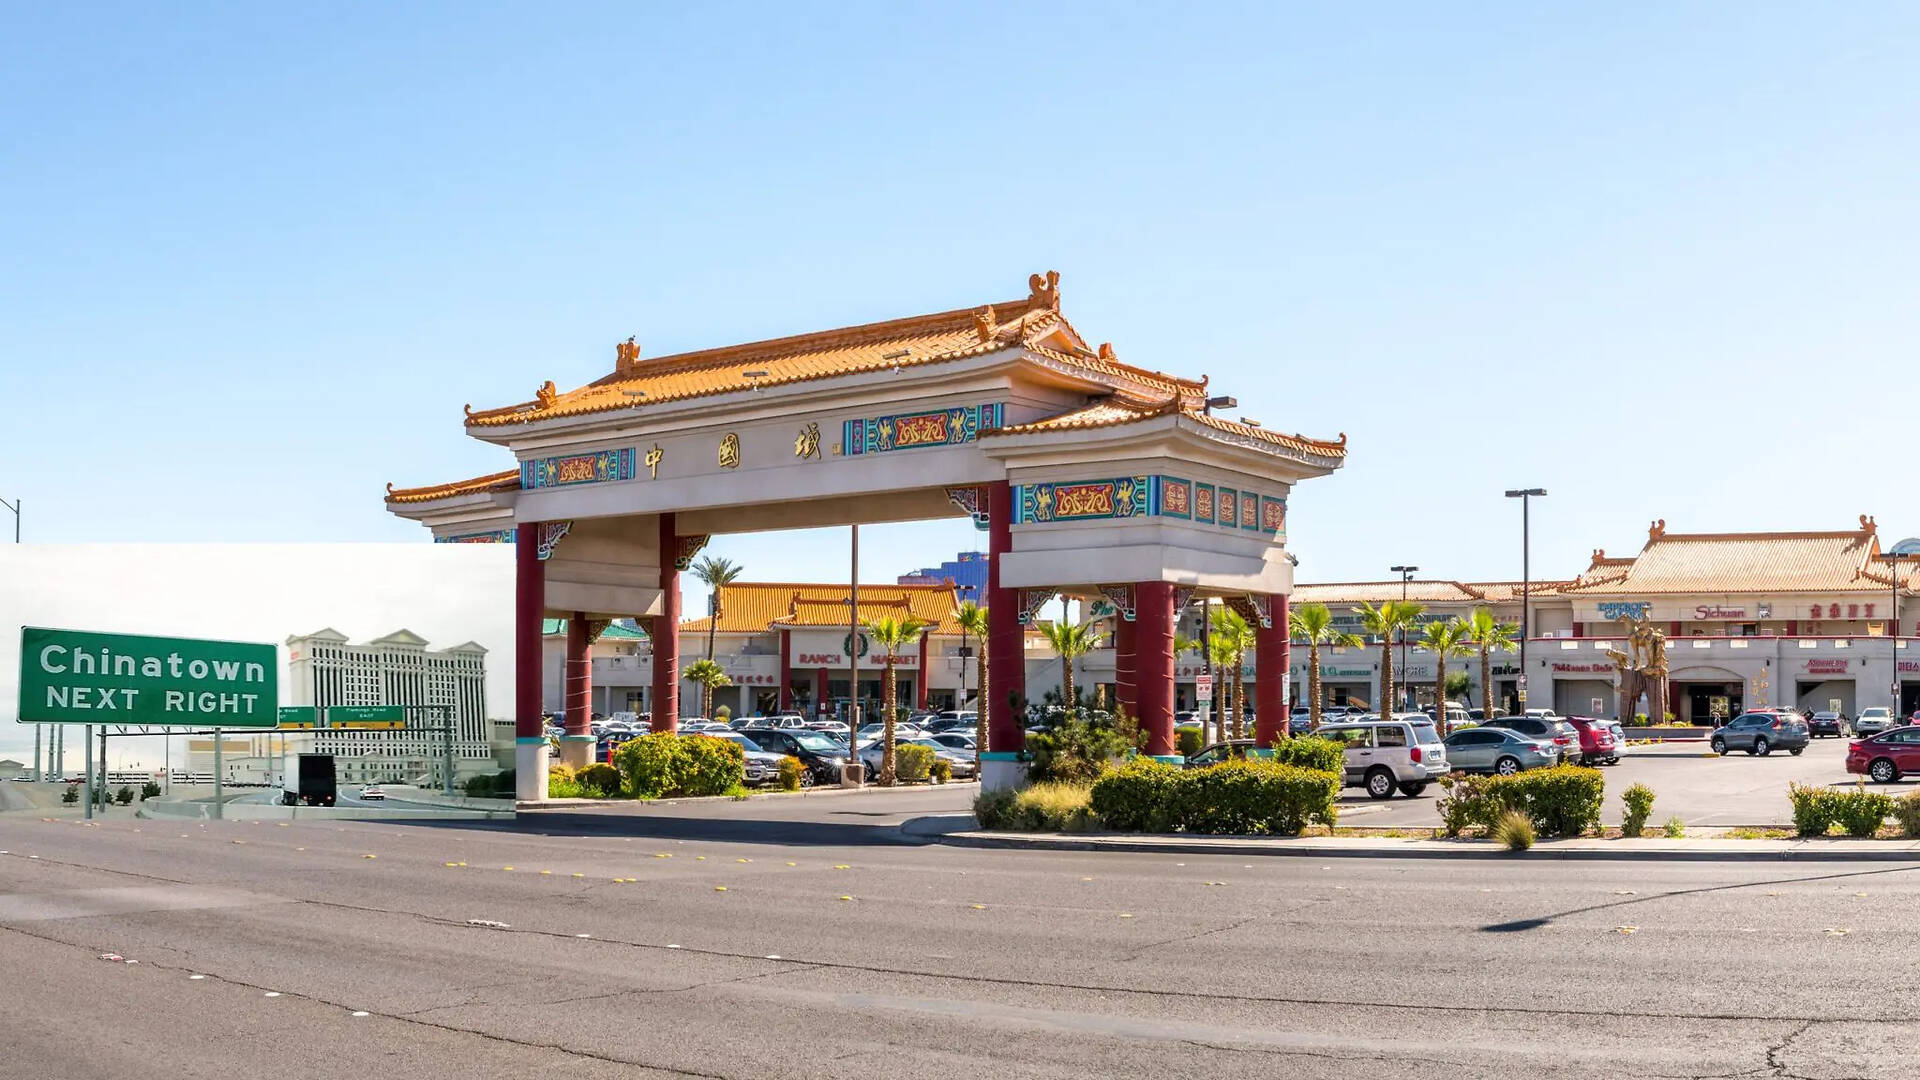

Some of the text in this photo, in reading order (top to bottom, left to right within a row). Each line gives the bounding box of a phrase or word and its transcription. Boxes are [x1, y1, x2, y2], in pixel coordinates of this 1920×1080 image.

[1694, 605, 1745, 620] Sichuan
[40, 644, 265, 682] Chinatown
[798, 653, 918, 665] RANCH MAKET
[46, 686, 259, 714] NEXT RIGHT
